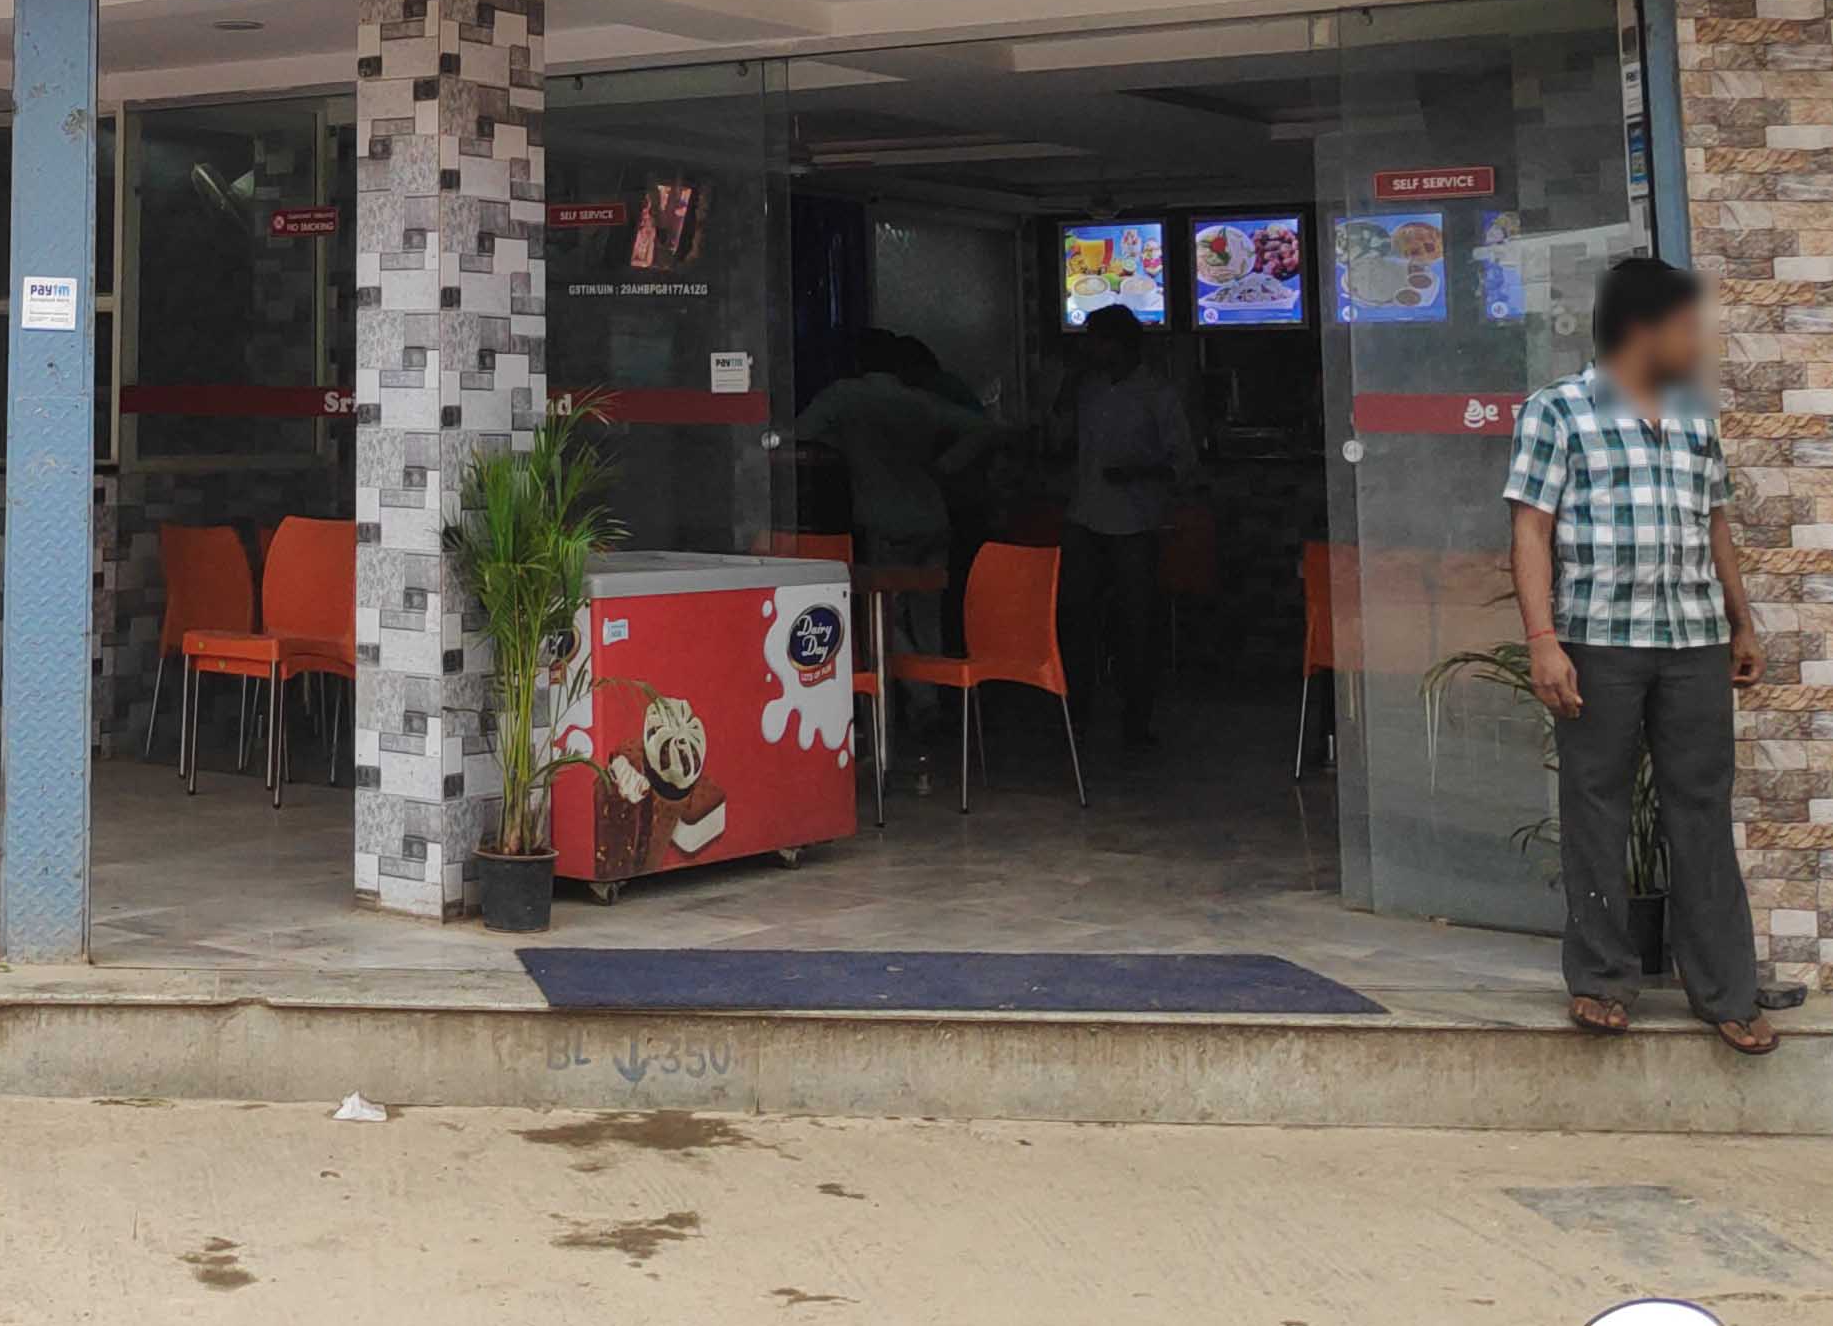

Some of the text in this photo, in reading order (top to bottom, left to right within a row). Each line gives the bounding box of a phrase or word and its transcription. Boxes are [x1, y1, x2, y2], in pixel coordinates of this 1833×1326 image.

[1392, 175, 1476, 191] SELF SERVICE
[797, 614, 833, 643] Dairy
[801, 634, 829, 664] Day
